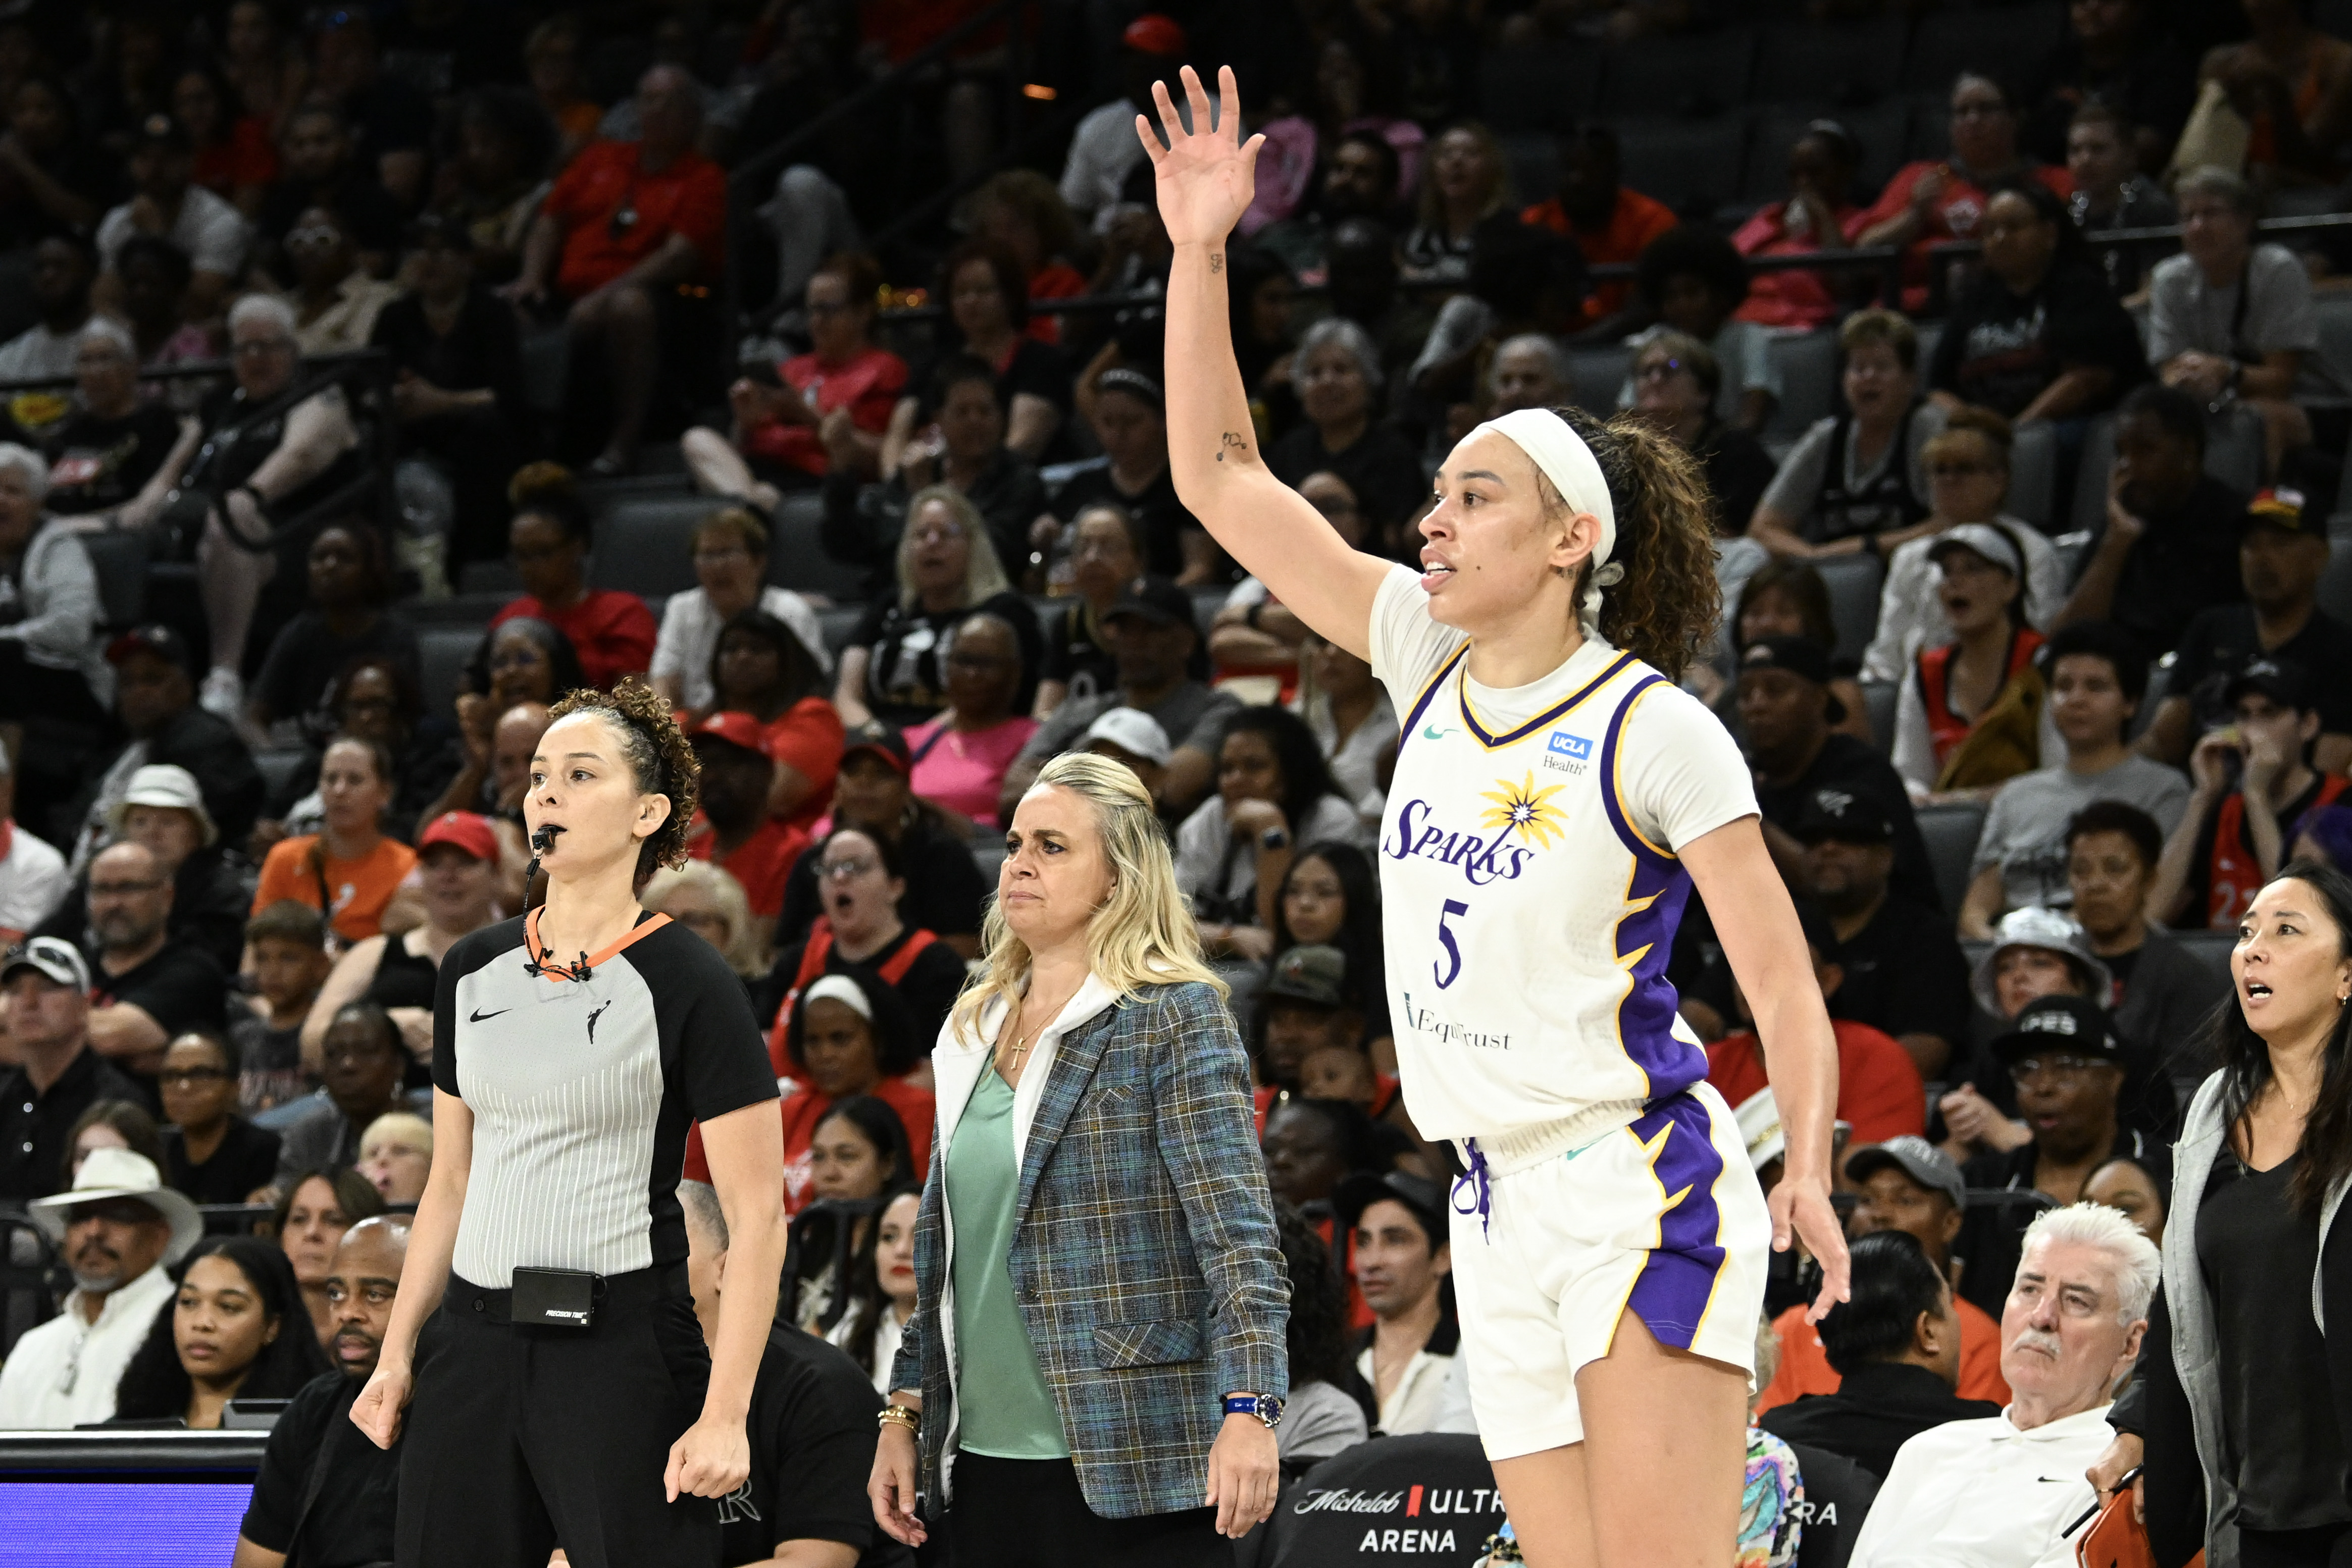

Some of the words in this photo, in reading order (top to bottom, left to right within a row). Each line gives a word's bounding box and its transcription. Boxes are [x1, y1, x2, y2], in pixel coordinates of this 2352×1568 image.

[1553, 736, 1585, 755] UCLA
[1434, 898, 1469, 989] 5
[1417, 1009, 1513, 1050] EquTrust
[545, 1310, 573, 1318] PRECISION
[1294, 1488, 1405, 1514] Michelob
[1429, 1489, 1507, 1514] ULTR
[1358, 1529, 1456, 1553] ARENA
